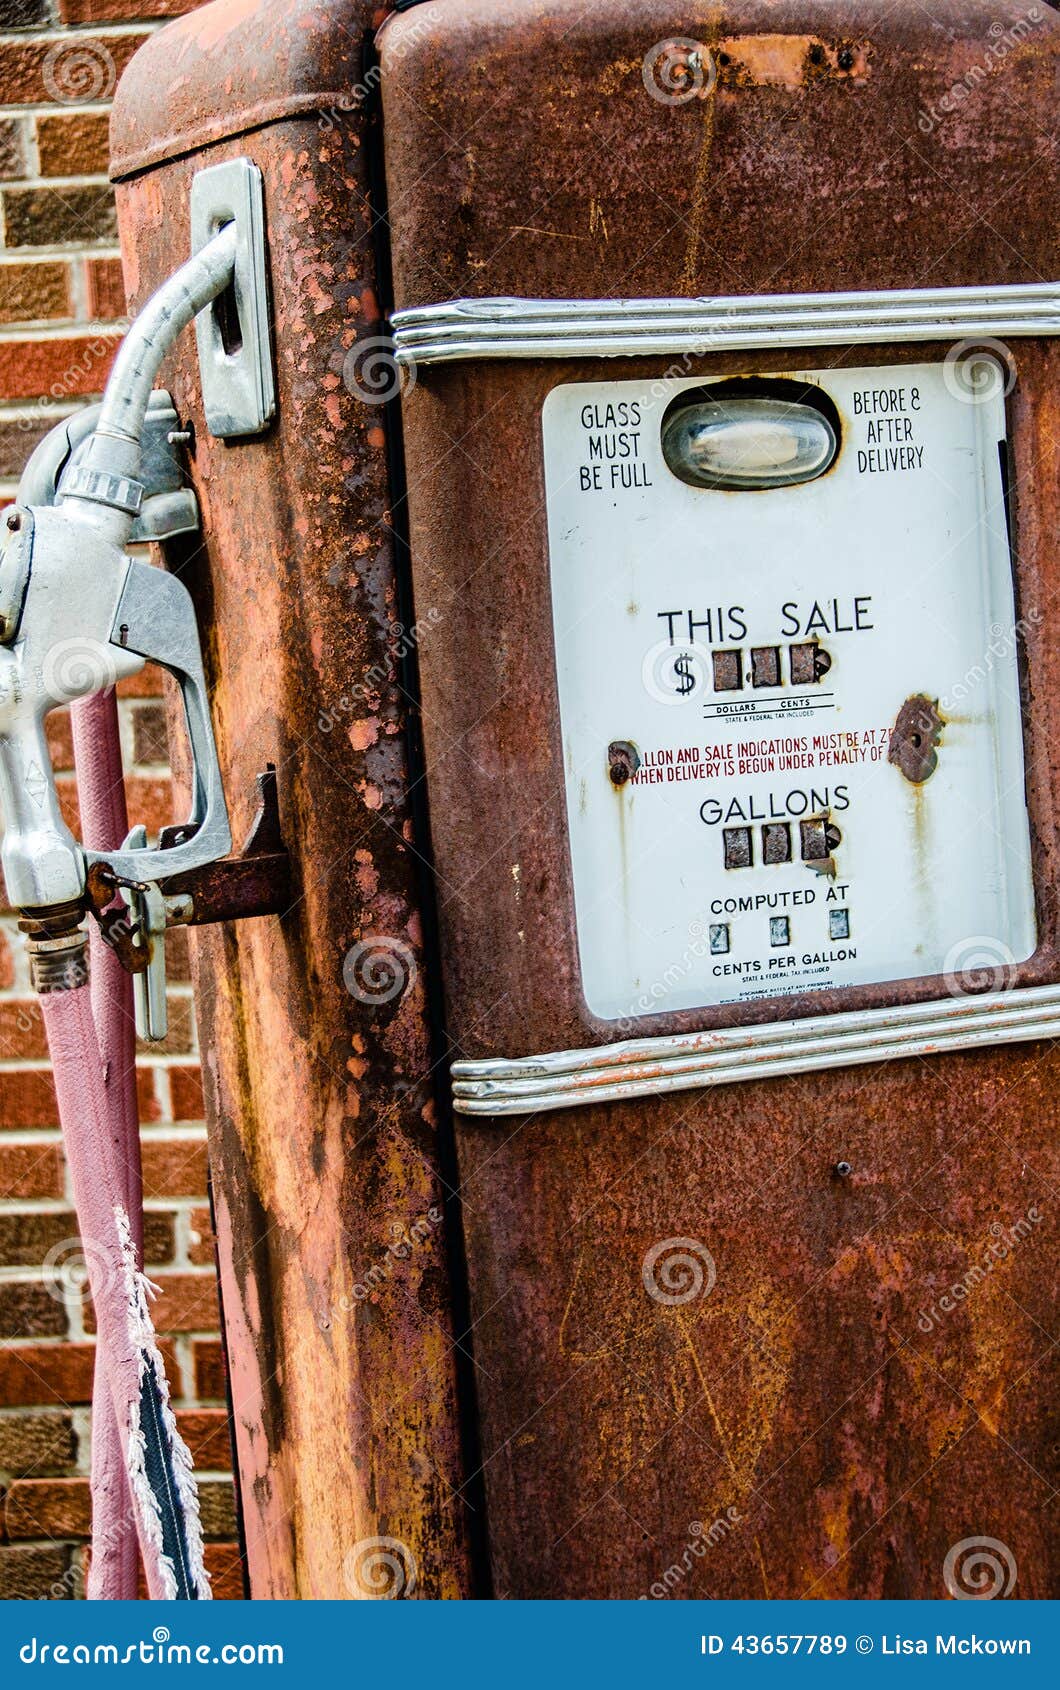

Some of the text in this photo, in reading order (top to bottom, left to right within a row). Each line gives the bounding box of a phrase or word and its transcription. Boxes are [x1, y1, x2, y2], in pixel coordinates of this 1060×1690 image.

[581, 402, 641, 429] GLASS
[853, 388, 907, 415] BEFORE
[867, 418, 914, 444] AFTER
[589, 432, 640, 460] MUST
[857, 446, 924, 473] DELIVERY
[580, 463, 652, 491] BE FULL
[657, 596, 874, 646] THIS SALE
[674, 653, 696, 696] $
[716, 699, 810, 714] DOLLARS CENTS
[725, 716, 741, 724] STATE
[642, 750, 673, 767] LLON
[677, 747, 700, 763] AND
[705, 743, 733, 761] SALE
[737, 737, 808, 758] INDICATIONS
[812, 734, 842, 750] MUST
[846, 732, 859, 747] BE
[863, 730, 876, 745] AT
[668, 762, 720, 782] DELIVERY
[724, 760, 735, 777] IS
[739, 755, 775, 774] BEGUN
[779, 752, 814, 770] UNDER
[819, 747, 866, 766] PENALTY
[870, 746, 883, 761] OF
[699, 785, 850, 824] GALLONS
[710, 885, 849, 914] COMPUTED AT
[712, 948, 857, 976] CENTS PER GALLON
[766, 972, 789, 980] FEDERAL
[803, 966, 830, 975] INCLUDED
